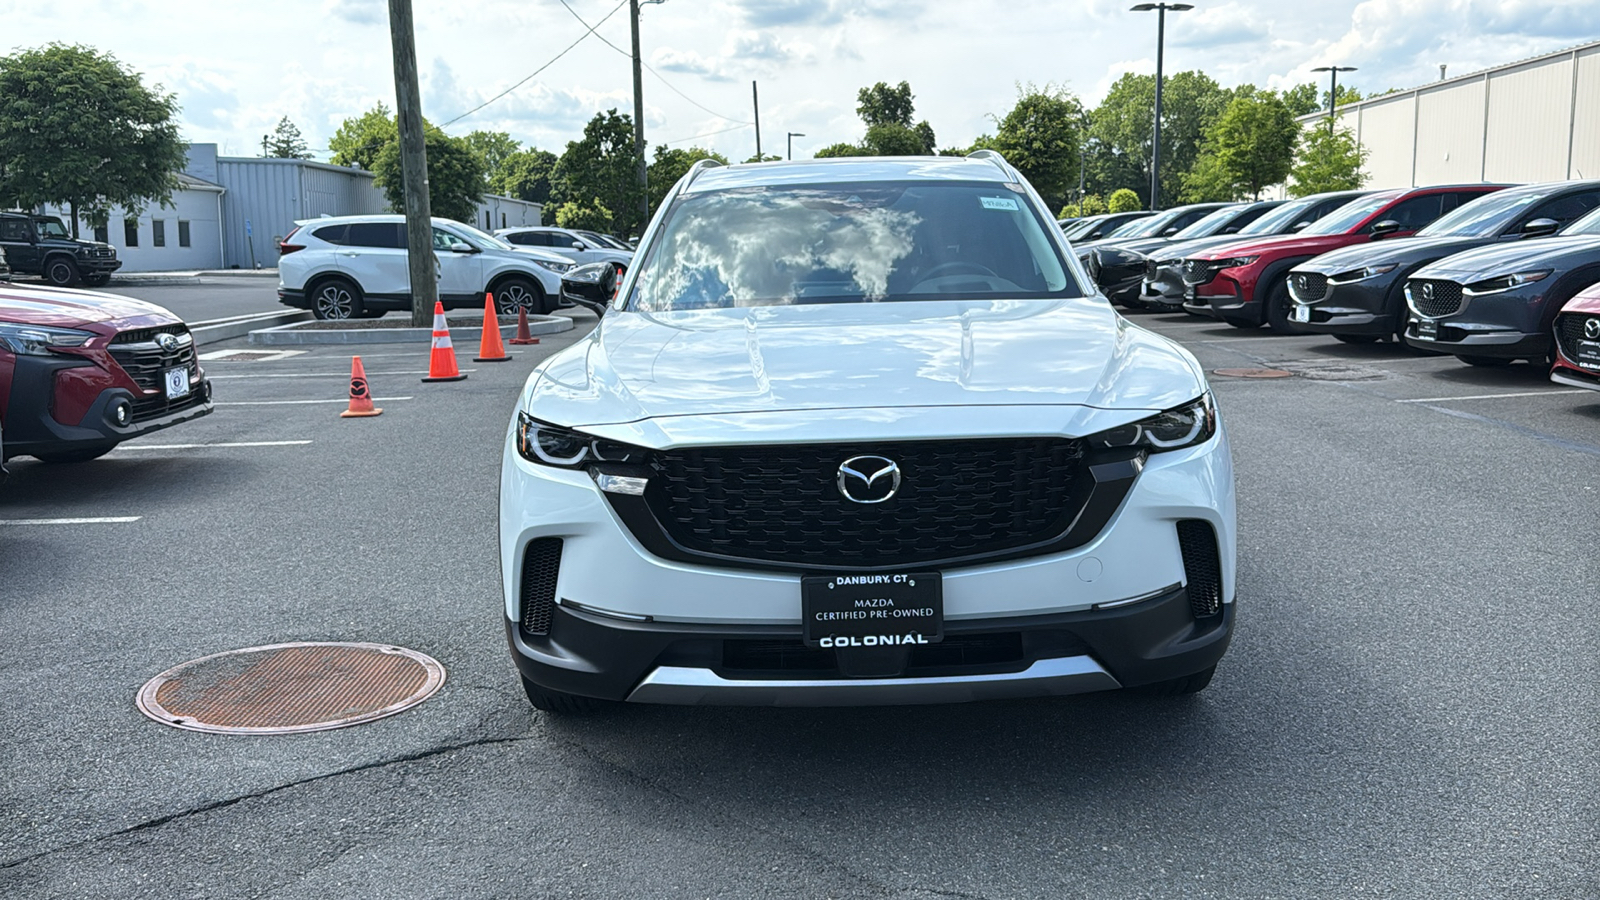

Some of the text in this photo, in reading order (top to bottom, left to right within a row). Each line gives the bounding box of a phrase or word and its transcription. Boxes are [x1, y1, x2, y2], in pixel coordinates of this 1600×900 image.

[836, 574, 908, 586] DANBURY, CT
[854, 598, 894, 608] MAZDA
[815, 608, 934, 621] CERTIFIED PRE-OWNED
[819, 633, 929, 648] COLONIAL
